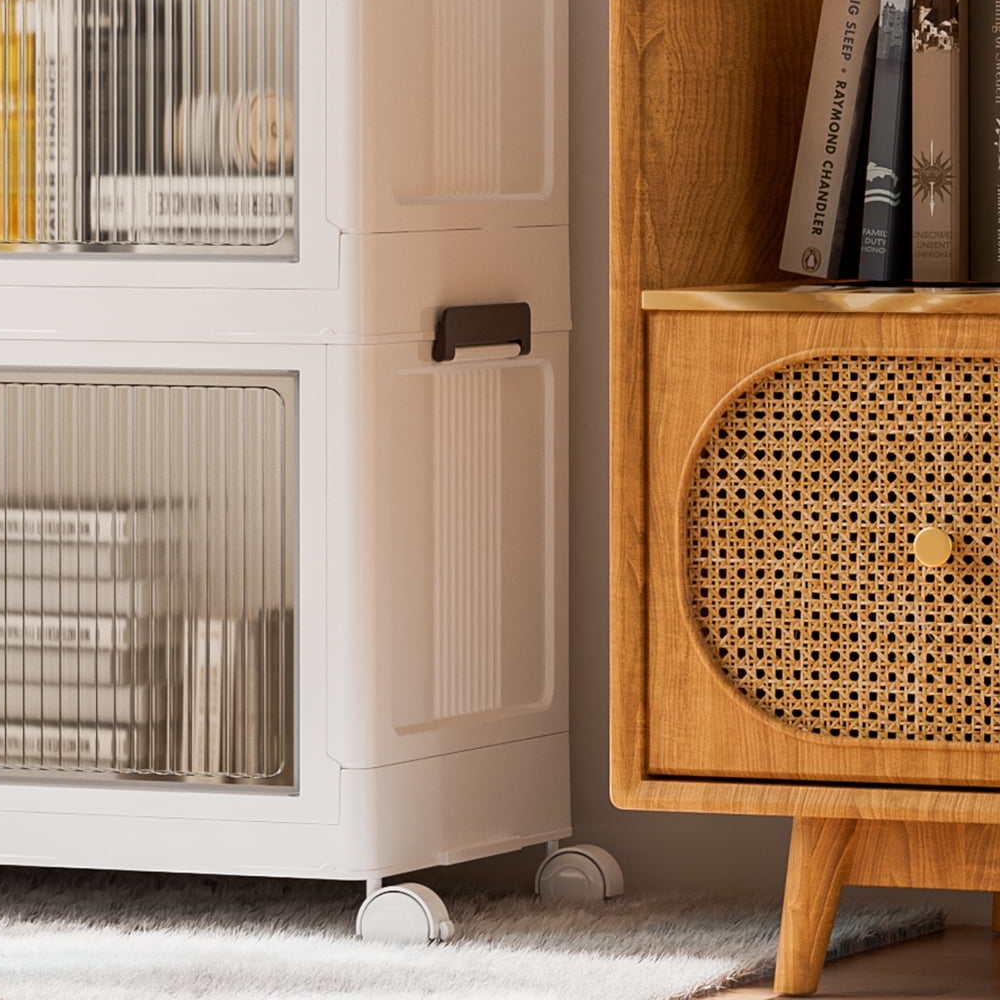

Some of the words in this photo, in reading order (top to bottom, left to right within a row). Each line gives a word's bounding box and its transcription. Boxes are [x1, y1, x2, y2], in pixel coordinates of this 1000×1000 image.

[841, 21, 857, 61] SLEEP
[824, 79, 847, 155] RAYMOND
[811, 159, 834, 236] CHANDLER
[862, 228, 888, 237] FAMIL
[864, 237, 888, 246] DUTY
